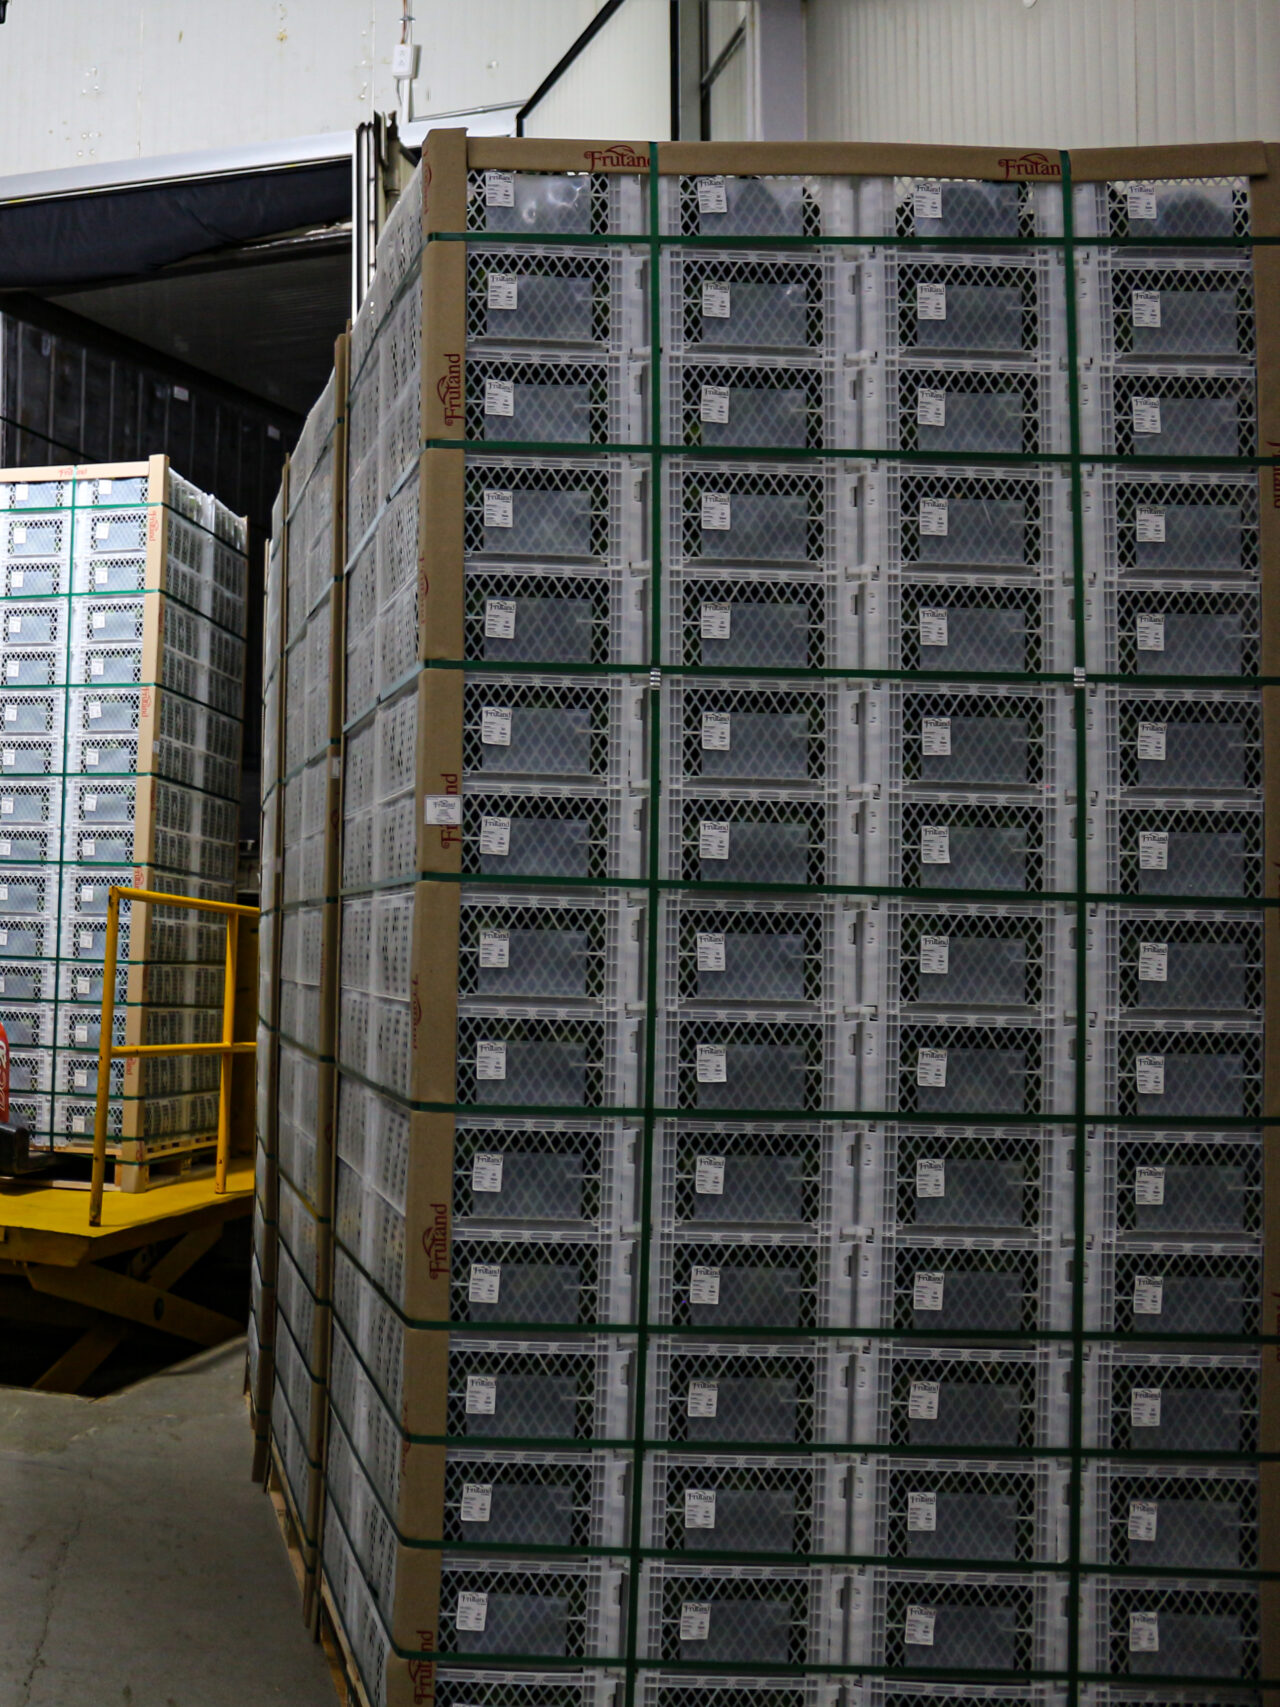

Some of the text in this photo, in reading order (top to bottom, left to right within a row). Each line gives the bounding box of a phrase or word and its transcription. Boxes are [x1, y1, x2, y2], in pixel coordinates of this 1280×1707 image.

[998, 156, 1061, 178] Frutan
[441, 353, 462, 427] Frutand
[425, 1203, 449, 1280] Frutand
[410, 1630, 435, 1705] Frutnd
